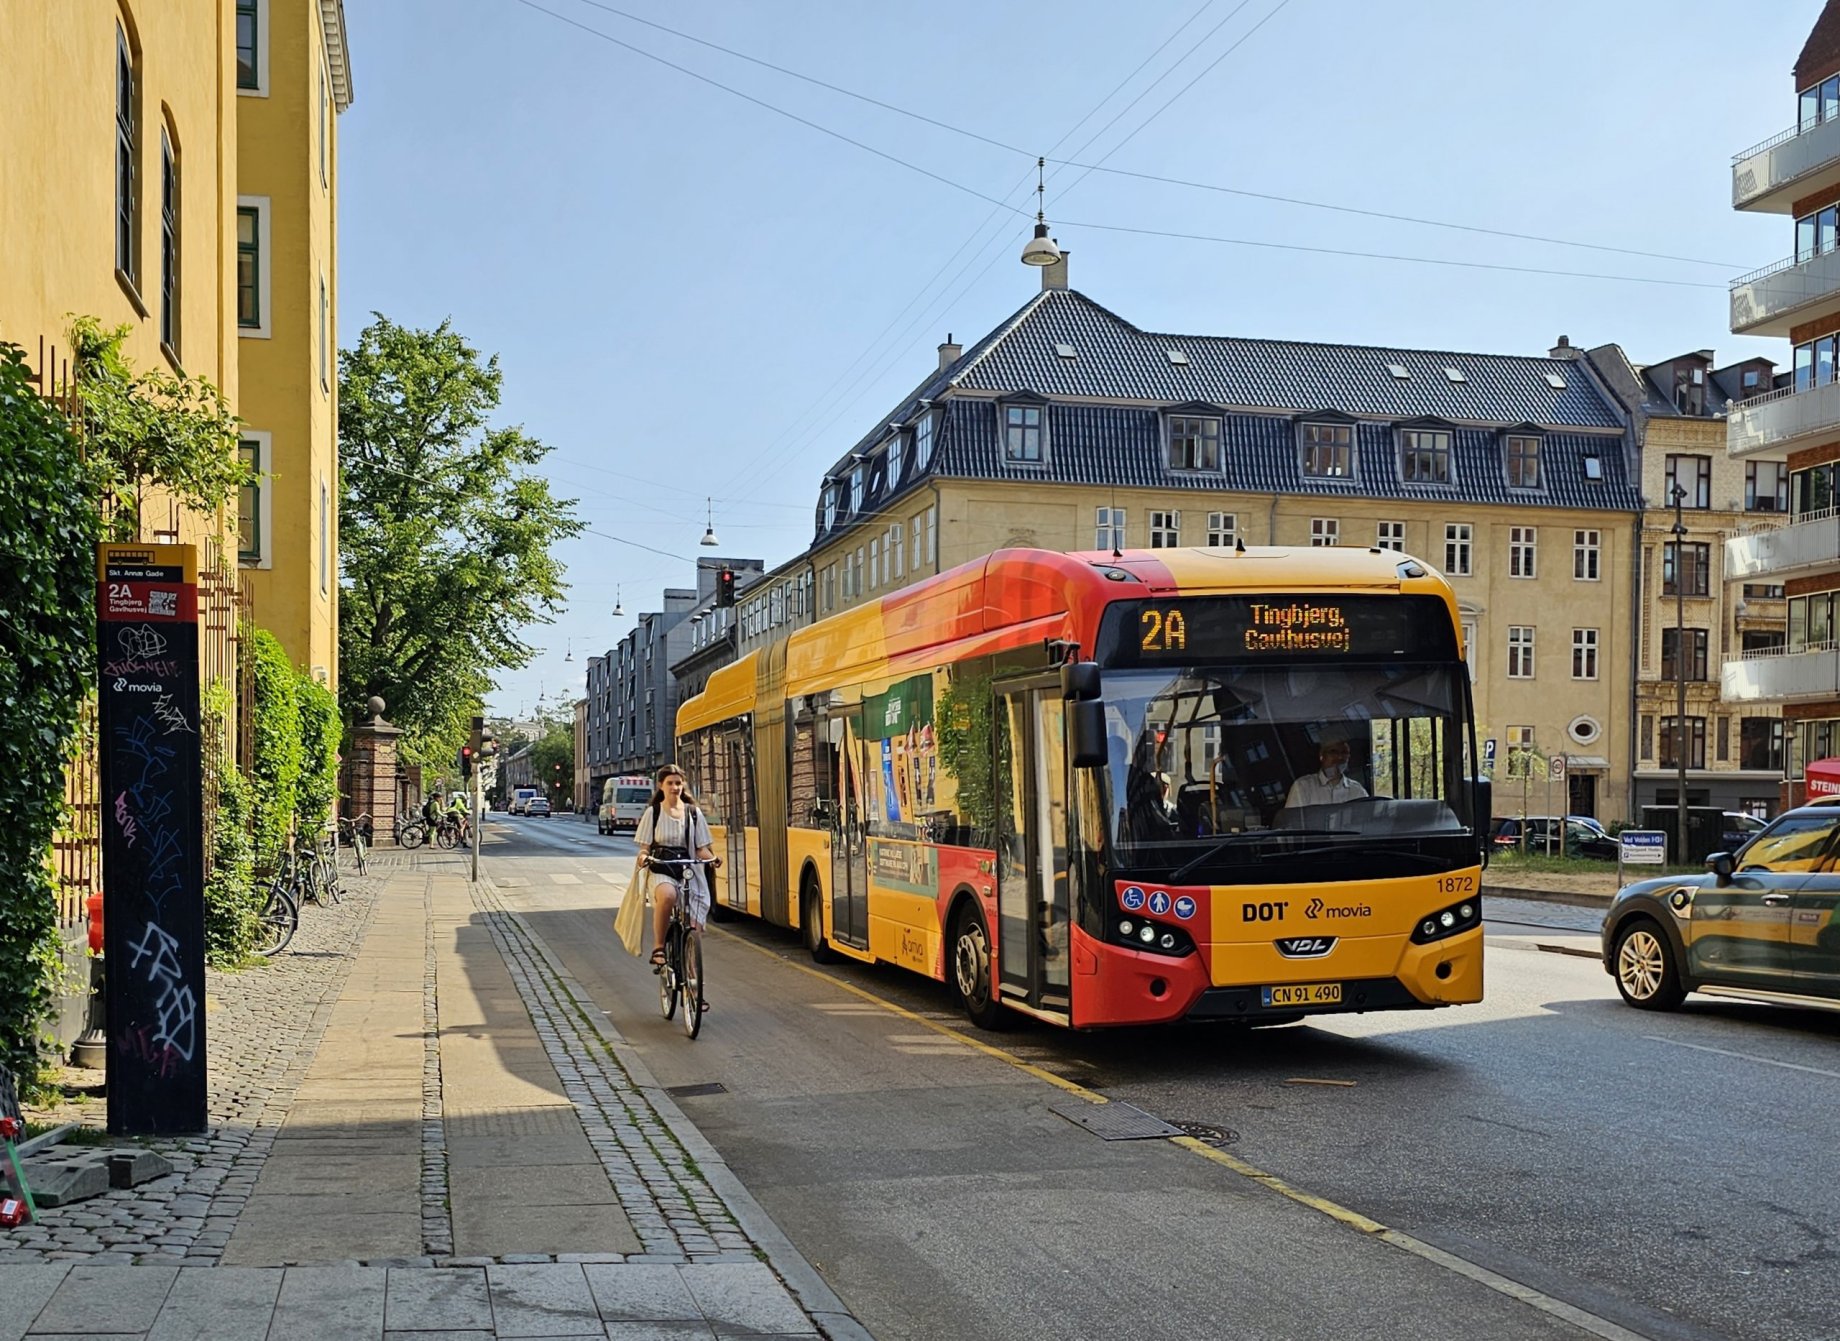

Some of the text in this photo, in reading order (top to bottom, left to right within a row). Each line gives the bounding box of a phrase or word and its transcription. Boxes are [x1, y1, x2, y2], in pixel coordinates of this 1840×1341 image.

[108, 584, 132, 598] 2A
[1250, 604, 1345, 628] Tingbjerg,
[1141, 609, 1186, 652] 2A
[128, 682, 162, 692] movia
[1810, 779, 1840, 795] STEIN
[1436, 876, 1473, 894] 1872
[1326, 903, 1372, 918] movia
[1284, 939, 1327, 952] VDL
[1272, 988, 1292, 1003] CN
[1294, 986, 1310, 1002] 91
[1314, 985, 1340, 1001] 490
